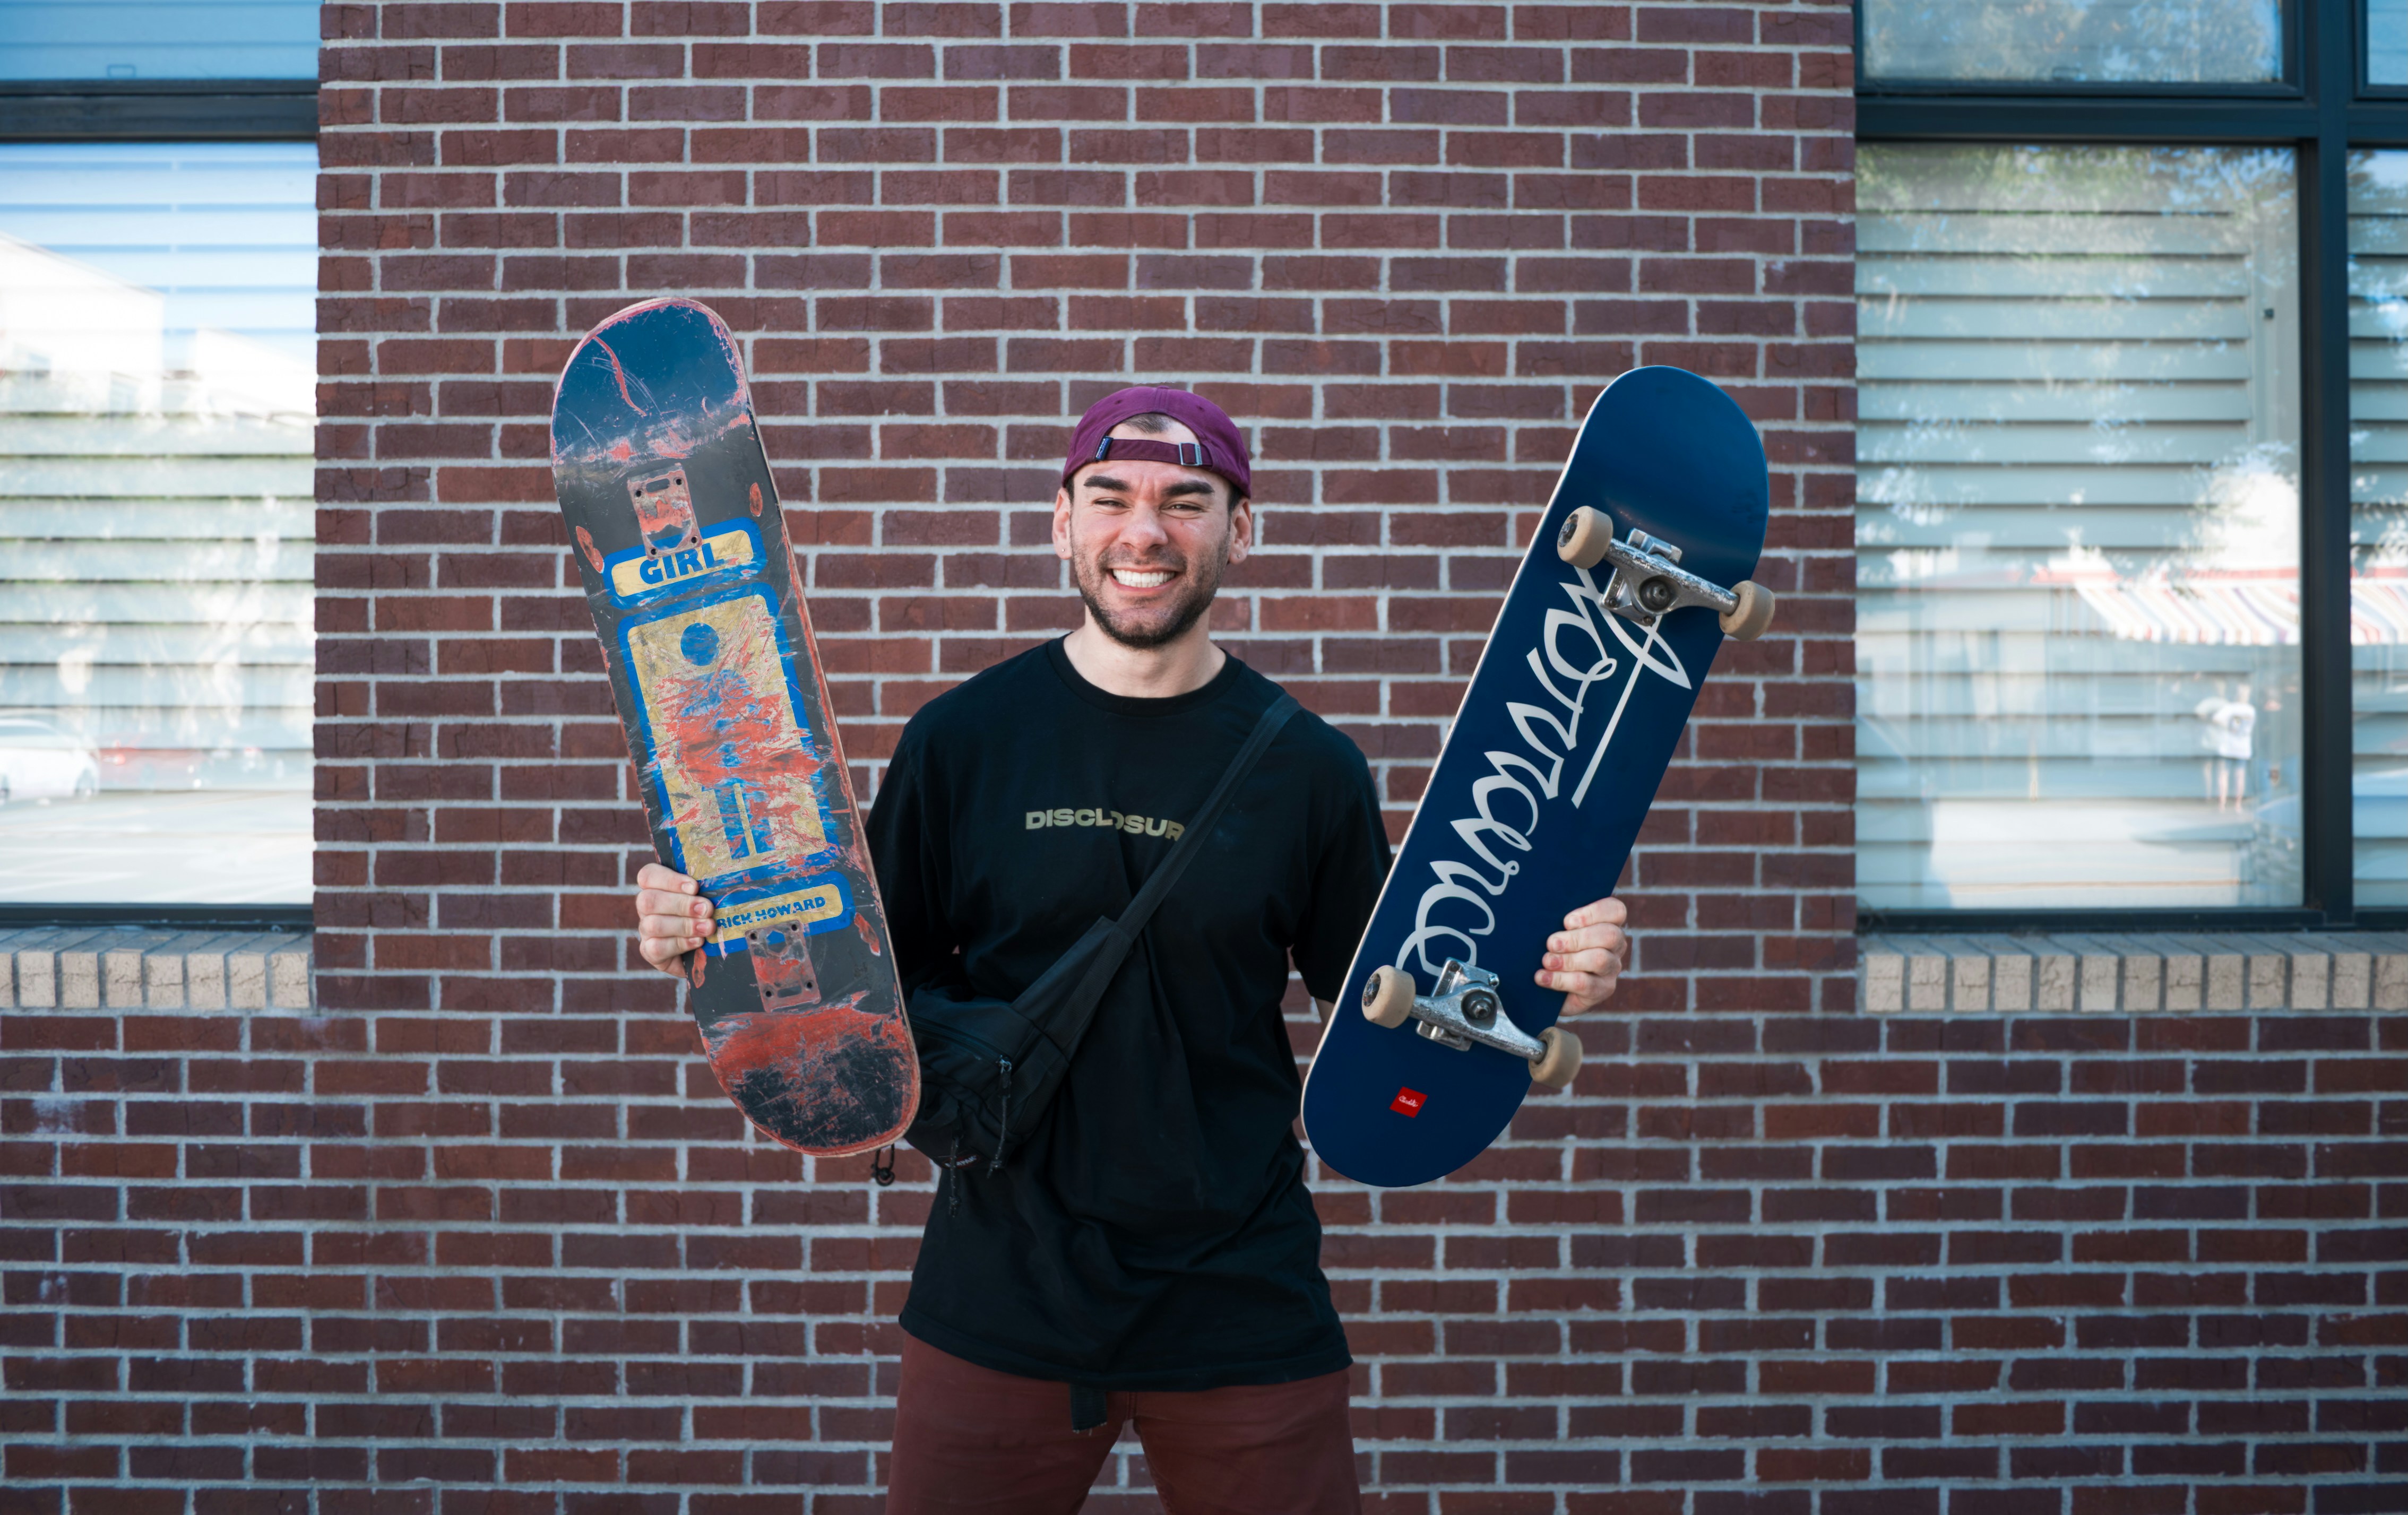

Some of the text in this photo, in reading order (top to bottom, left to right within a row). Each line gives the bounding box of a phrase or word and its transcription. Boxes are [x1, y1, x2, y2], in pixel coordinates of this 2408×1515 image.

[639, 542, 725, 585] GIRL
[1025, 808, 1185, 842] DISCLOSUR
[717, 896, 826, 929] RICK HOWARD
